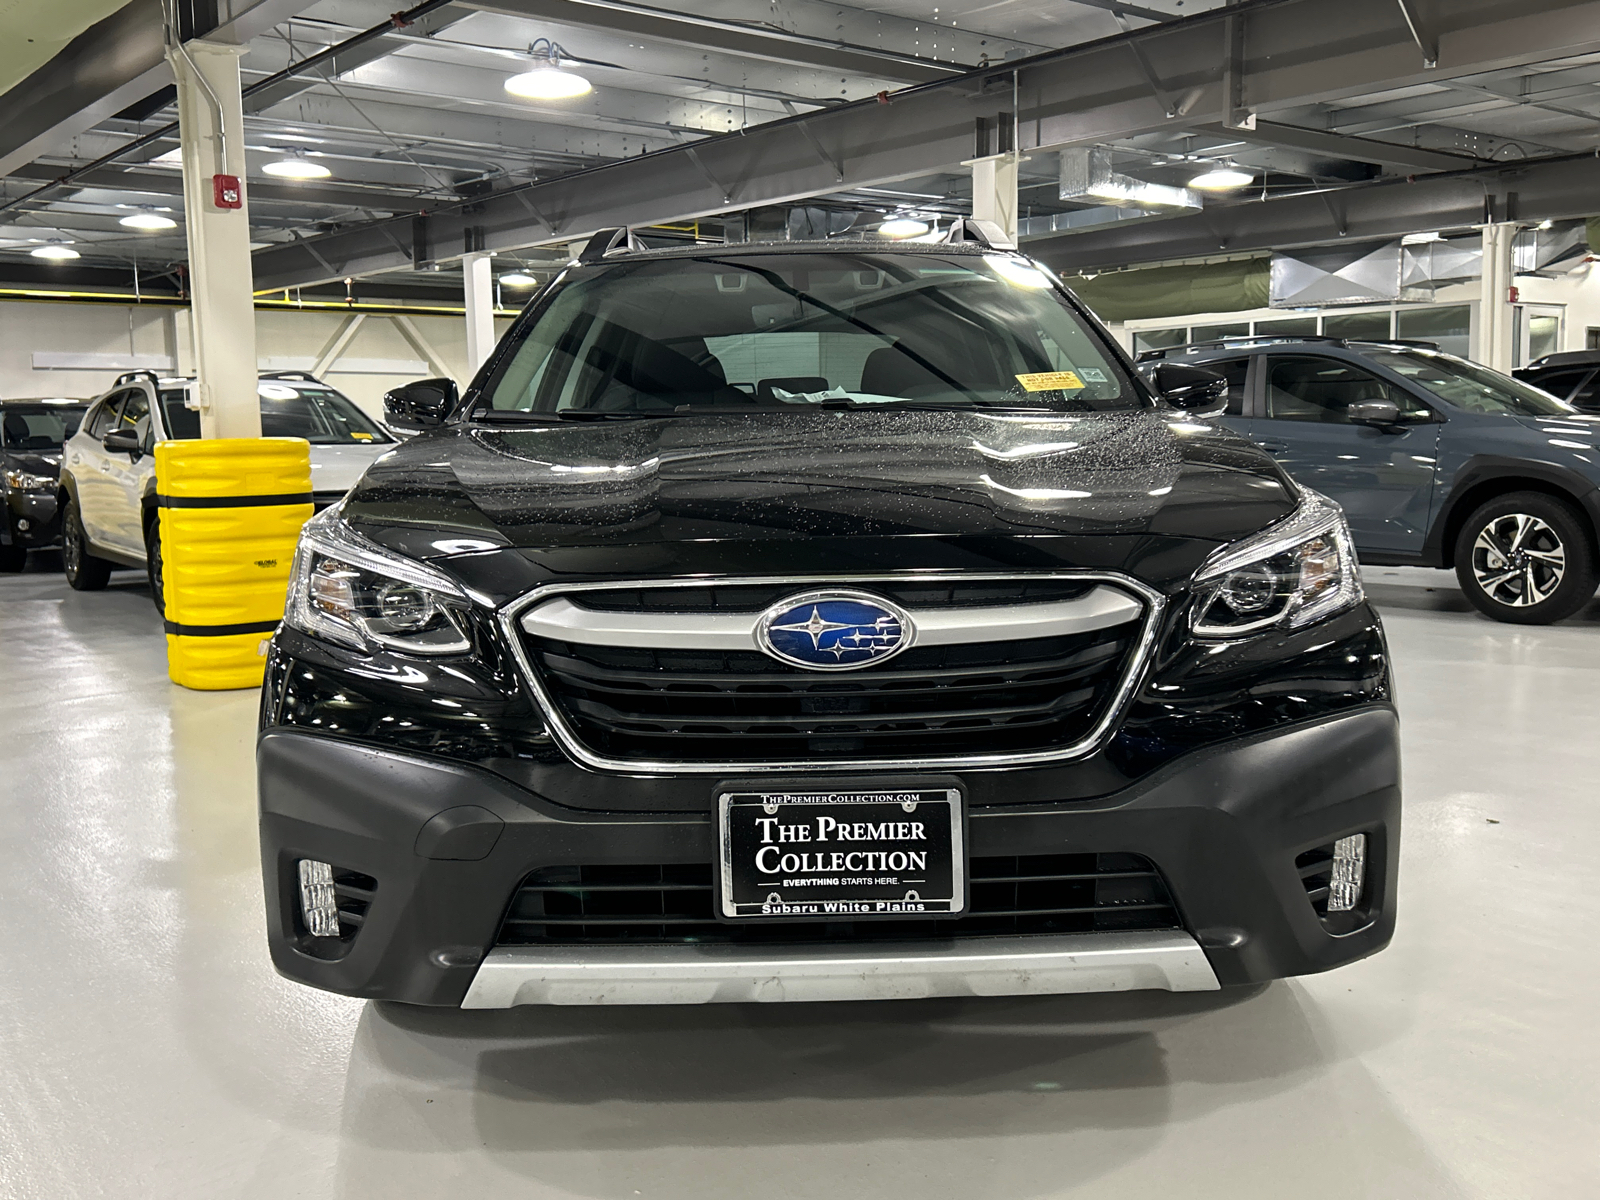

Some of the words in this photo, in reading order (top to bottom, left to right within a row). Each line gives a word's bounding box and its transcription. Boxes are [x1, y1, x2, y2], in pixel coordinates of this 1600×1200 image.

[755, 817, 811, 843] THE
[816, 816, 926, 842] PREMIER
[755, 846, 927, 874] COLLECTION
[783, 878, 839, 887] EVERYTHING
[841, 877, 873, 886] STARTS
[874, 877, 900, 885] HERE.
[762, 904, 818, 914] Subaru
[824, 903, 870, 913] White
[876, 901, 925, 912] Plains
